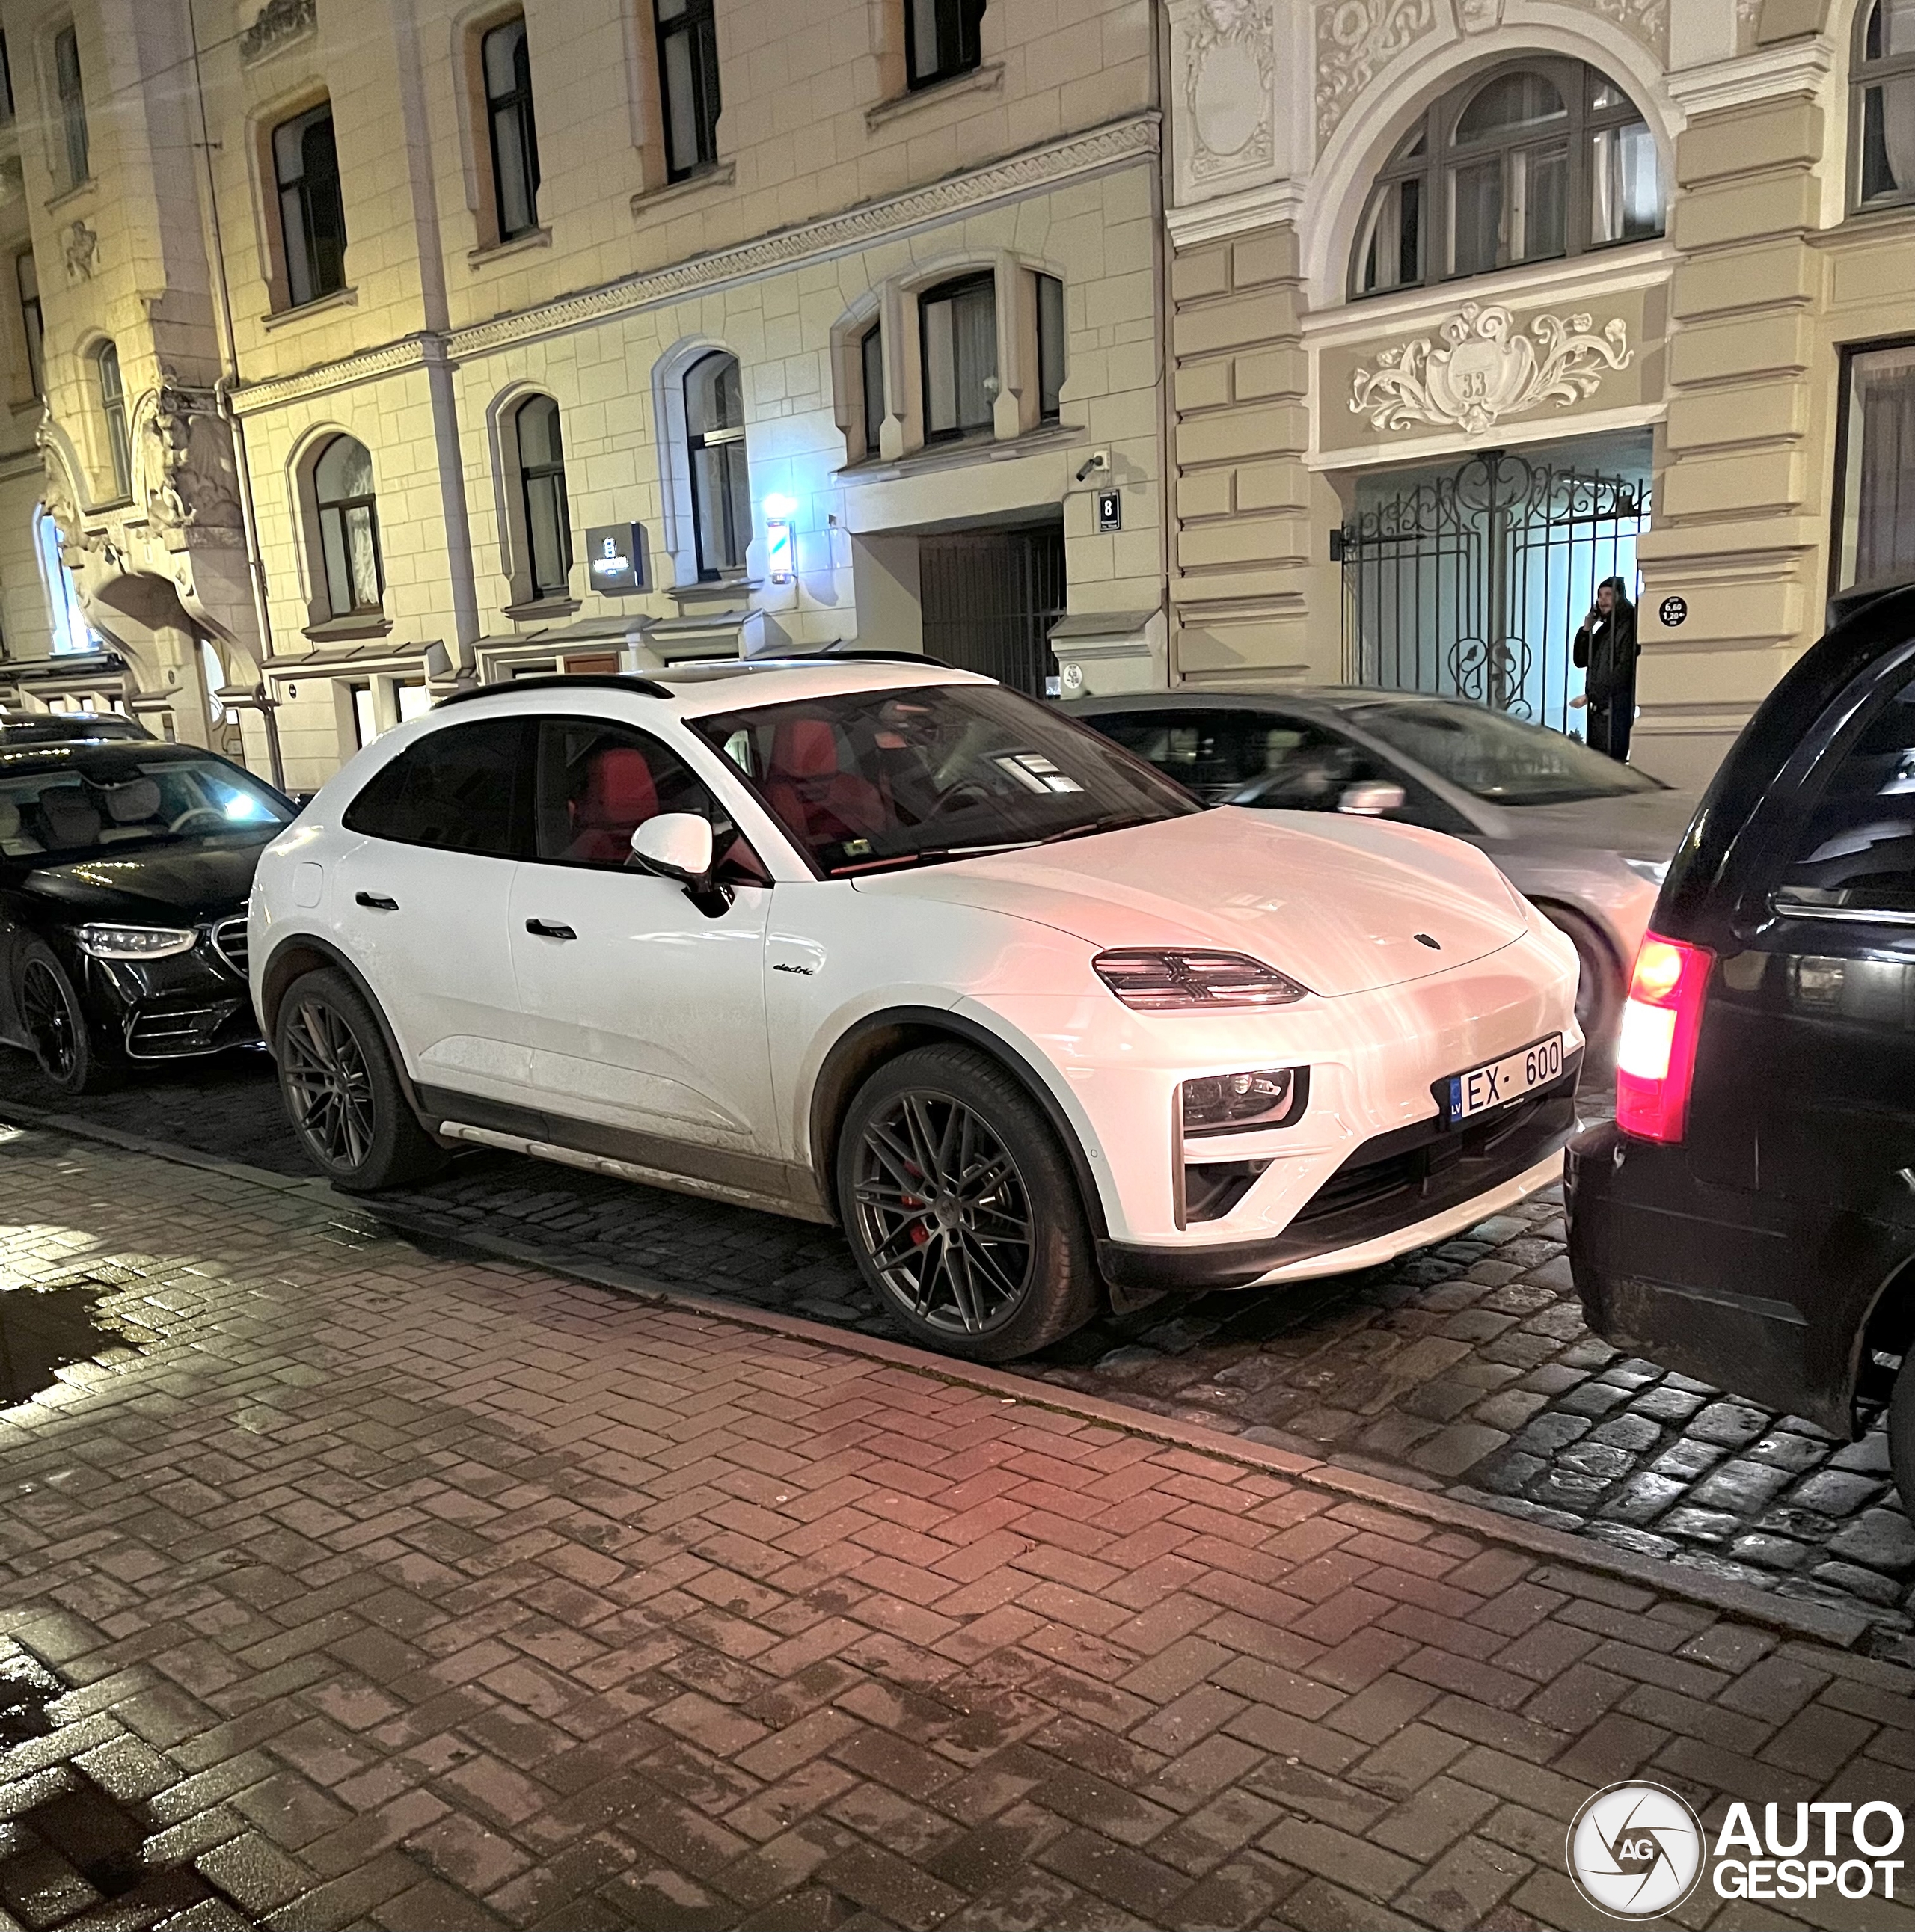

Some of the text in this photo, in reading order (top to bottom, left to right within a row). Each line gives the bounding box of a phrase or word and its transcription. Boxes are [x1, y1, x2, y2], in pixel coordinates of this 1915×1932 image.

[1463, 372, 1486, 398] 33
[1105, 500, 1112, 516] 8
[773, 963, 814, 976] electric
[1526, 1041, 1559, 1085] 600
[1451, 1103, 1461, 1115] LV
